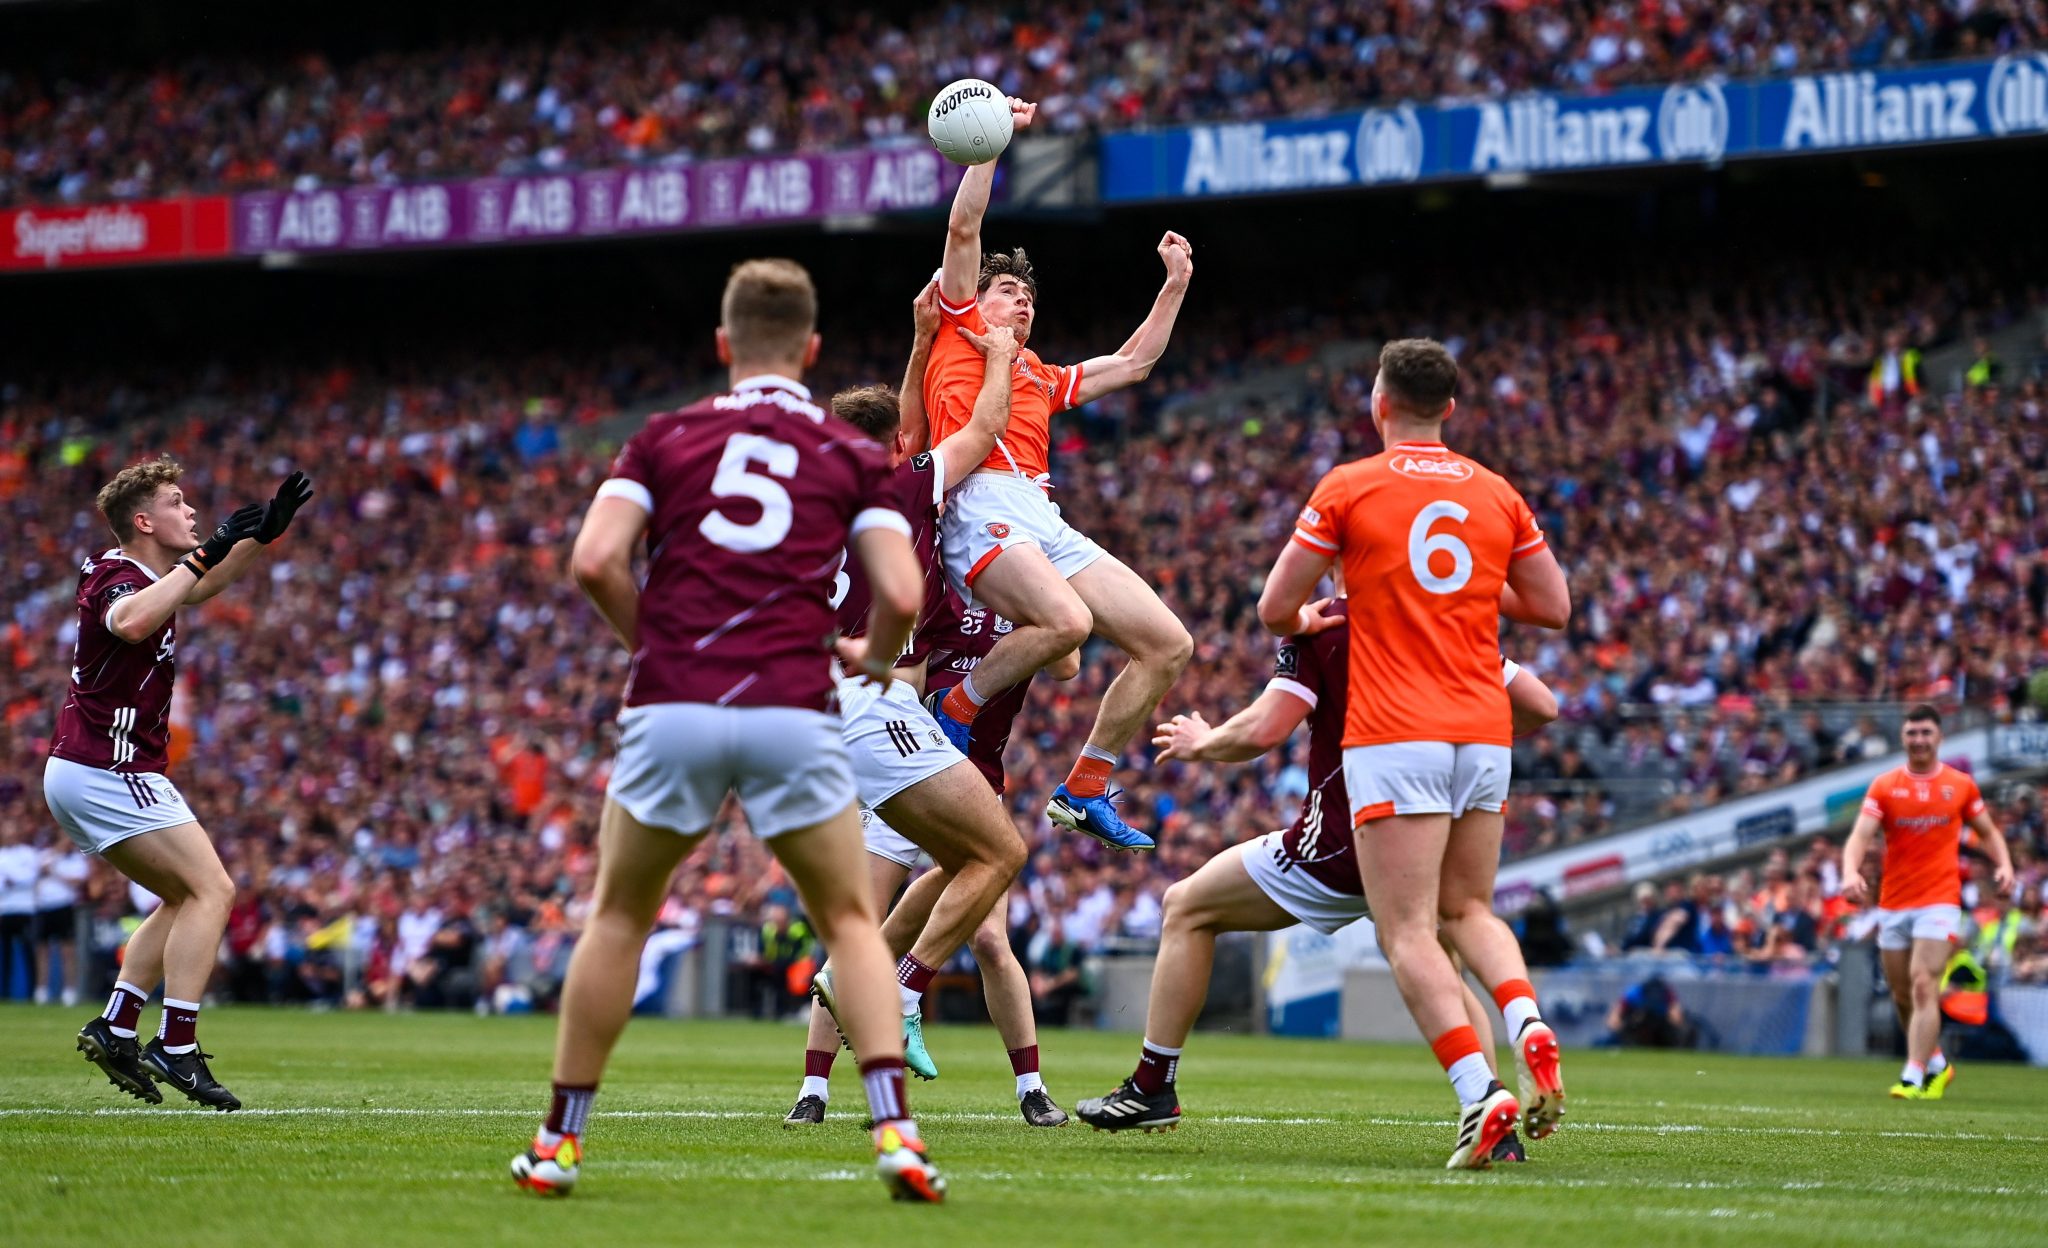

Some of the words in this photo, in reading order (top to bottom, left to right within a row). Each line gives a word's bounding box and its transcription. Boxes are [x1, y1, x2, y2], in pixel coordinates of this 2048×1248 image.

[1471, 95, 1652, 172] Allianz
[1782, 72, 1977, 150] Allianz
[740, 159, 813, 218] AIB
[865, 151, 941, 210] AIB
[1183, 123, 1351, 195] Allianz
[383, 184, 450, 241] AIB
[506, 178, 575, 235] AIB
[617, 170, 689, 226] AIB
[699, 431, 799, 553] 5
[1407, 499, 1474, 595] 6
